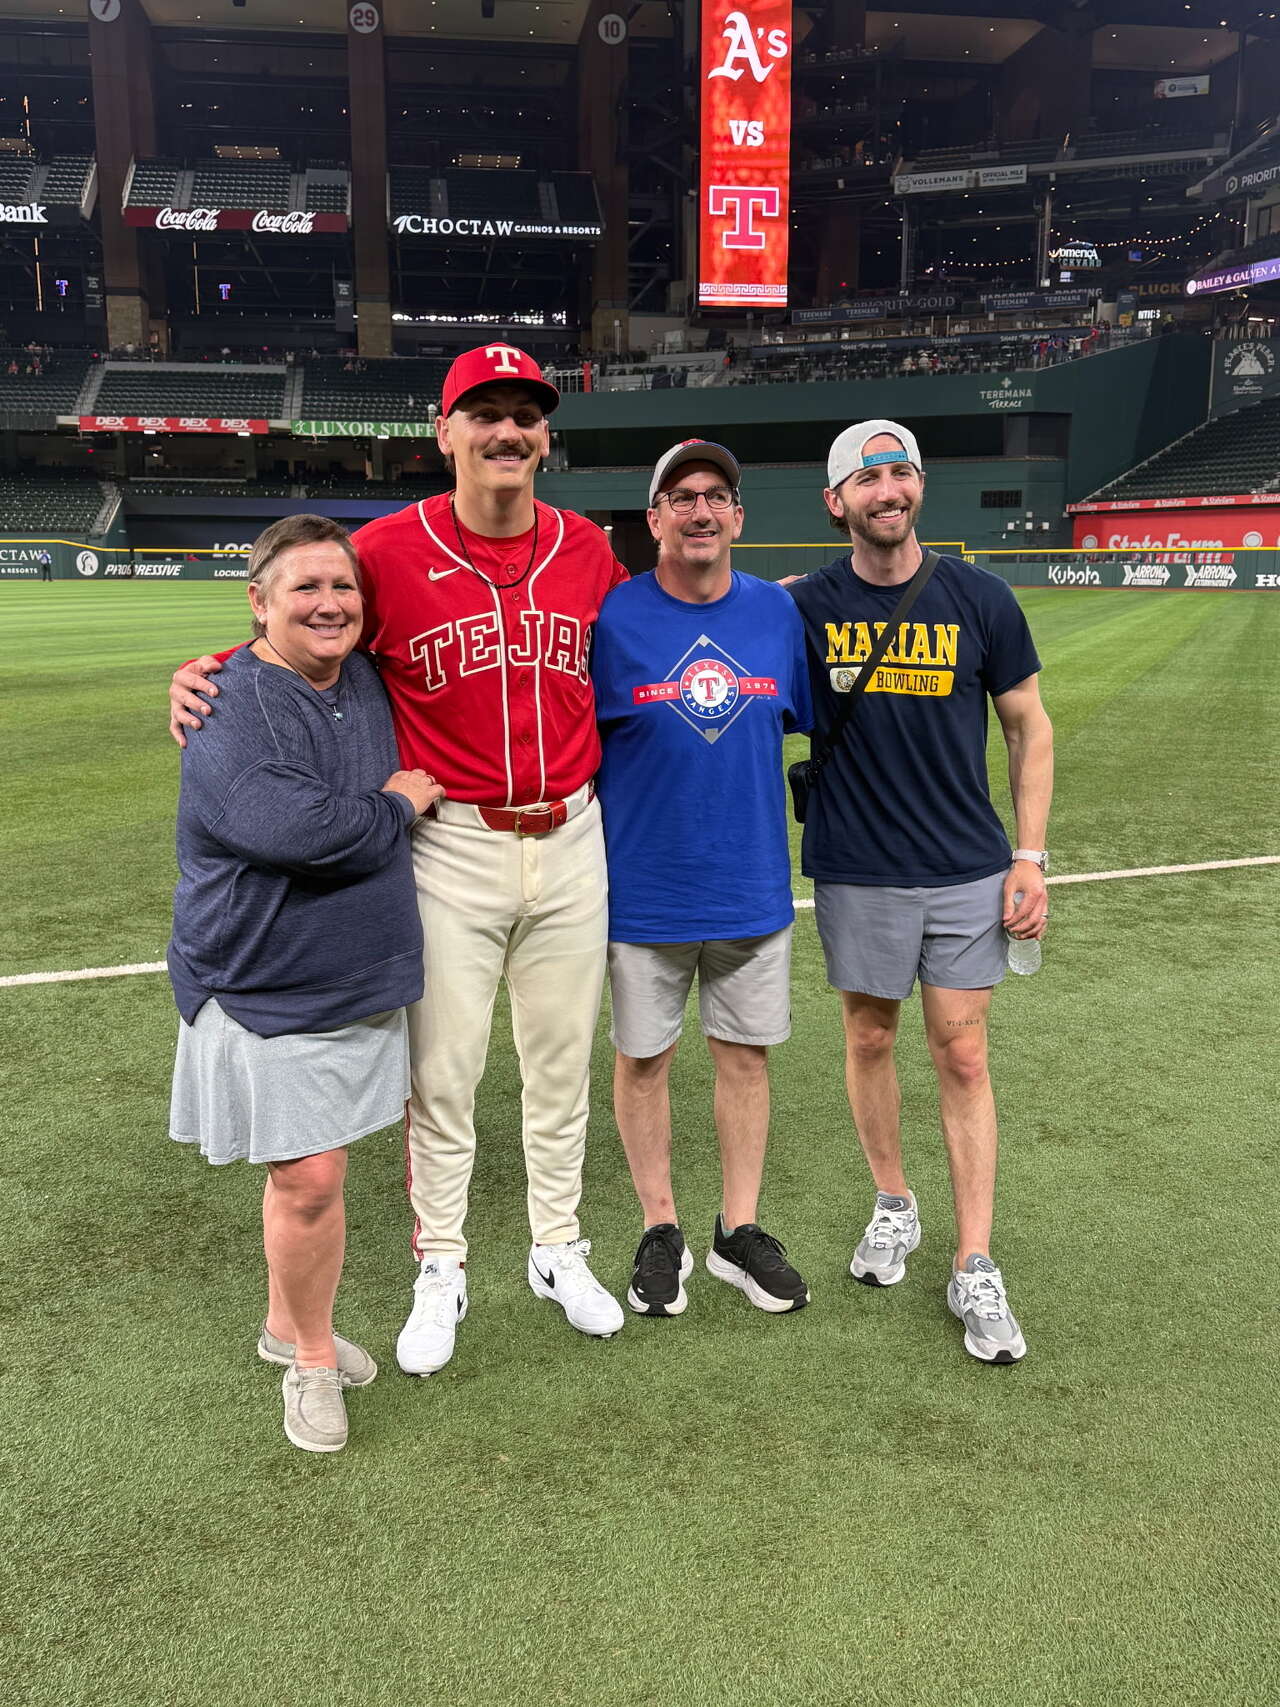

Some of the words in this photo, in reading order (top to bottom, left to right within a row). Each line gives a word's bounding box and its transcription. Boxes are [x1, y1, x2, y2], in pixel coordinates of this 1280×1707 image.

[353, 9, 375, 26] 29
[604, 20, 619, 38] 10
[1241, 166, 1280, 187] PRIORIT
[709, 185, 780, 250] T
[406, 215, 514, 236] CHOCTAW
[514, 225, 552, 234] CASINOS
[563, 226, 601, 235] RESORTS
[1049, 258, 1102, 268] CKYARD
[56, 279, 68, 296] T
[1196, 275, 1225, 290] BAILEY
[1225, 274, 1233, 284] &
[219, 283, 231, 300] T
[918, 296, 955, 309] GOLD
[485, 346, 521, 374] T
[979, 389, 1033, 399] TEREMANA
[989, 400, 1022, 408] TERRACE
[96, 416, 125, 425] DEX
[138, 418, 167, 427] DEX
[179, 418, 208, 427] DEX
[220, 419, 249, 428] DEX
[310, 421, 378, 436] LUXOR
[1048, 565, 1101, 585] Kubota
[1134, 565, 1165, 578] ARROW
[1197, 565, 1229, 580] ARROW
[687, 662, 728, 676] TEXAS
[698, 677, 720, 700] T
[876, 671, 939, 692] BOWLING
[639, 687, 674, 698] SINCE
[685, 690, 735, 714] RANGERS
